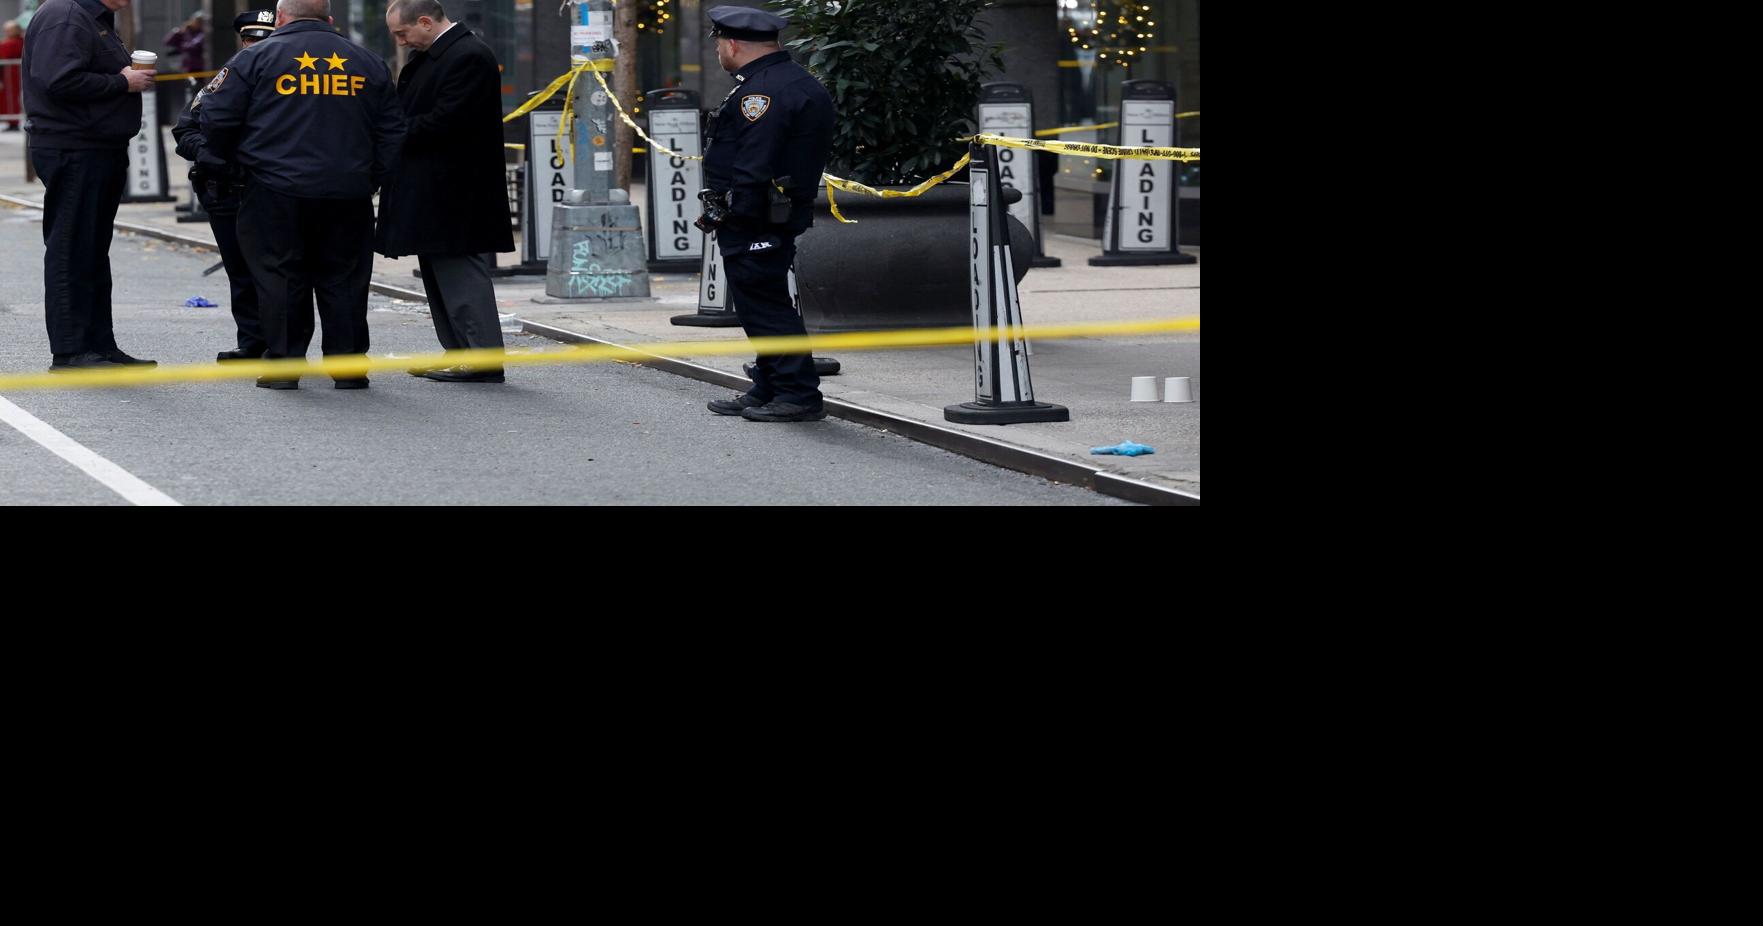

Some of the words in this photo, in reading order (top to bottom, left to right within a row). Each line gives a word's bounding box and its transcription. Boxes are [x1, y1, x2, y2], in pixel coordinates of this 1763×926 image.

[276, 73, 366, 96] CHIEF
[138, 120, 150, 190] OADING
[1102, 147, 1117, 155] SCENE
[1137, 129, 1155, 243] LADING
[669, 137, 690, 252] LOADING
